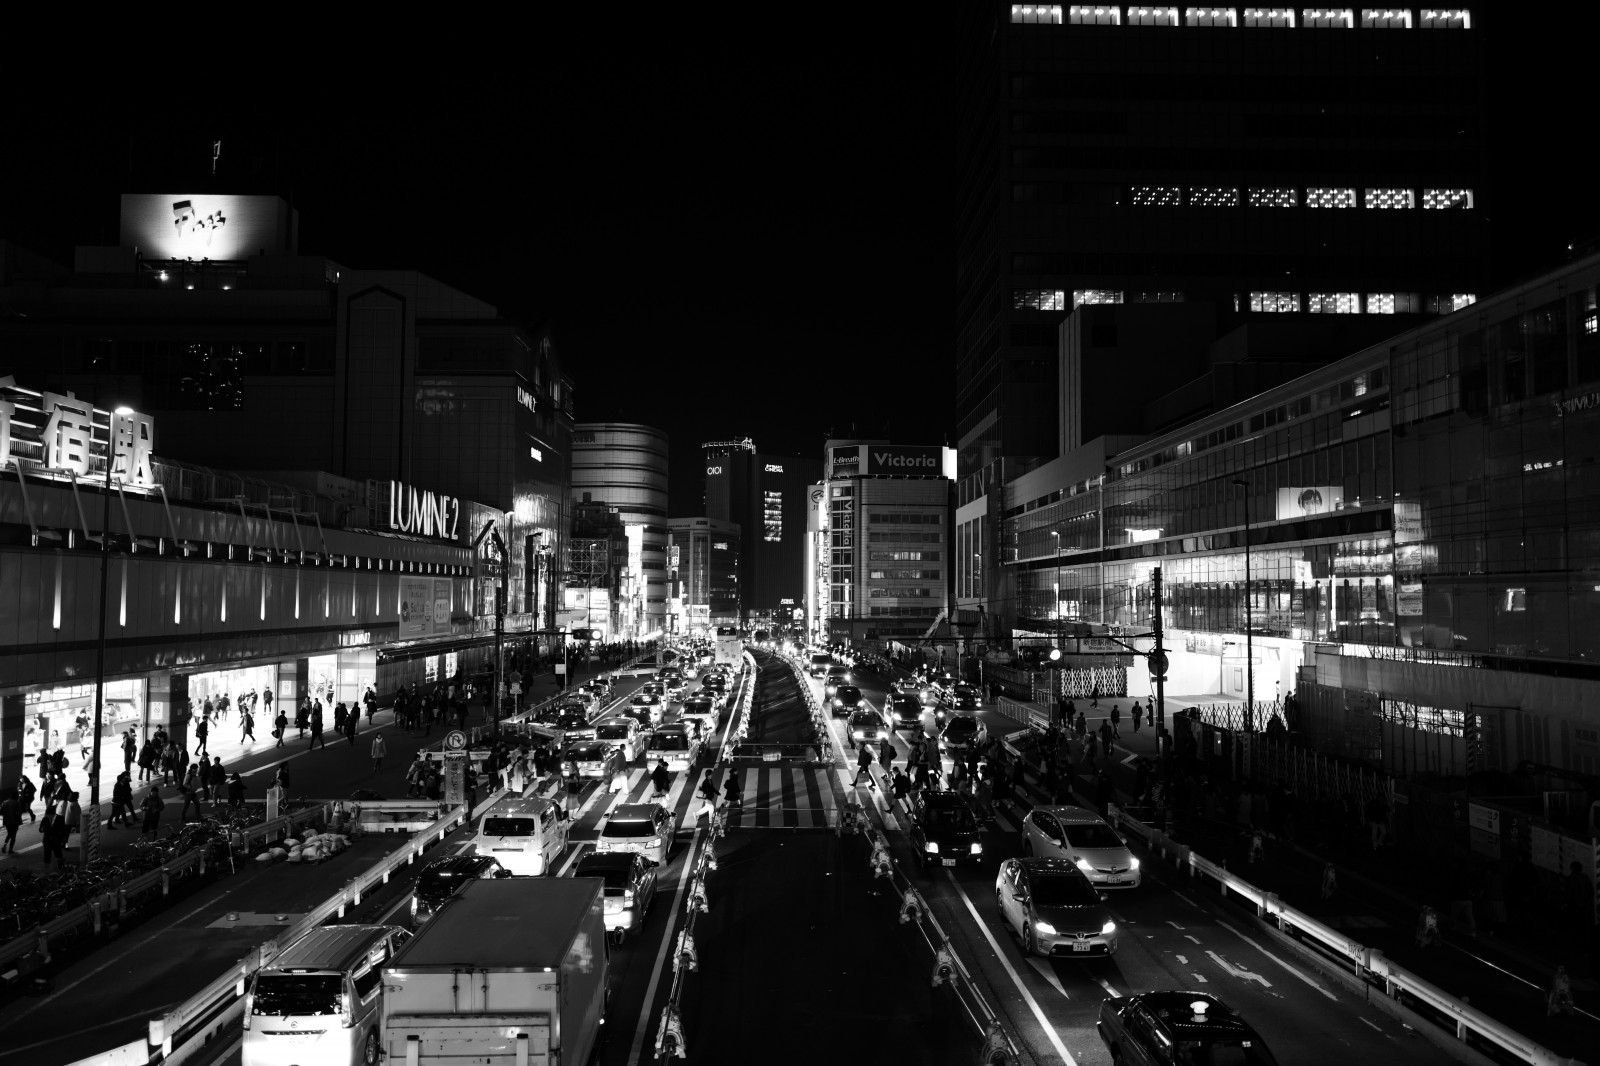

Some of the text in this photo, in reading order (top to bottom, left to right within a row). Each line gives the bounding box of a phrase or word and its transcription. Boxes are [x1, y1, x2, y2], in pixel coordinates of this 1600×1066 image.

[873, 452, 937, 467] Victoria
[390, 480, 459, 540] LUMINE2
[844, 500, 852, 545] Victoria
